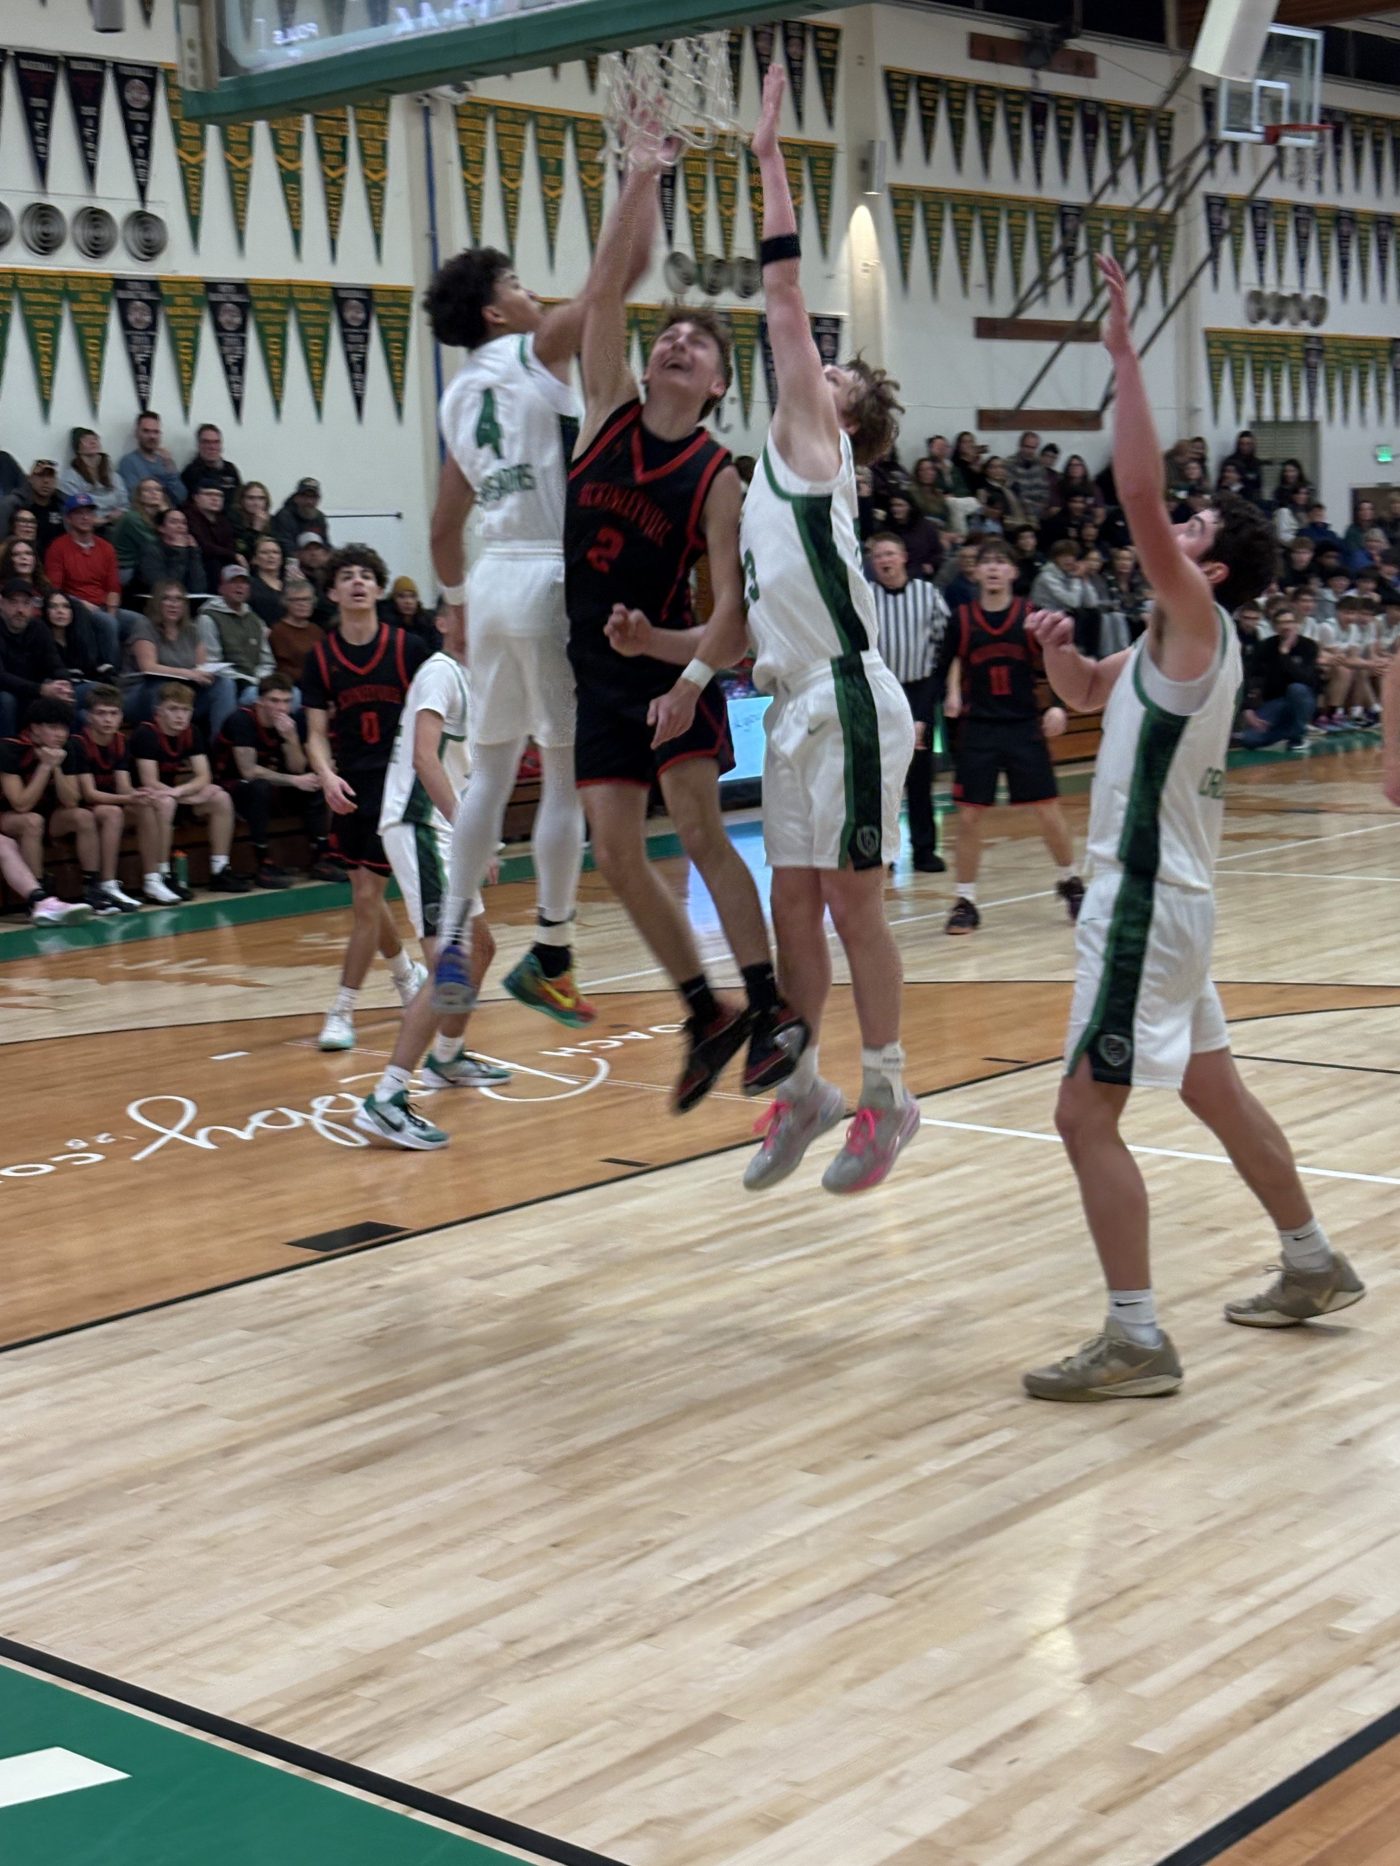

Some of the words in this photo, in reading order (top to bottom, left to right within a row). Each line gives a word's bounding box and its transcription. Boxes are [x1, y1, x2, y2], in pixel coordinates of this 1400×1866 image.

[586, 526, 625, 574] 2
[360, 712, 381, 744] 0
[538, 1015, 692, 1058] OACH
